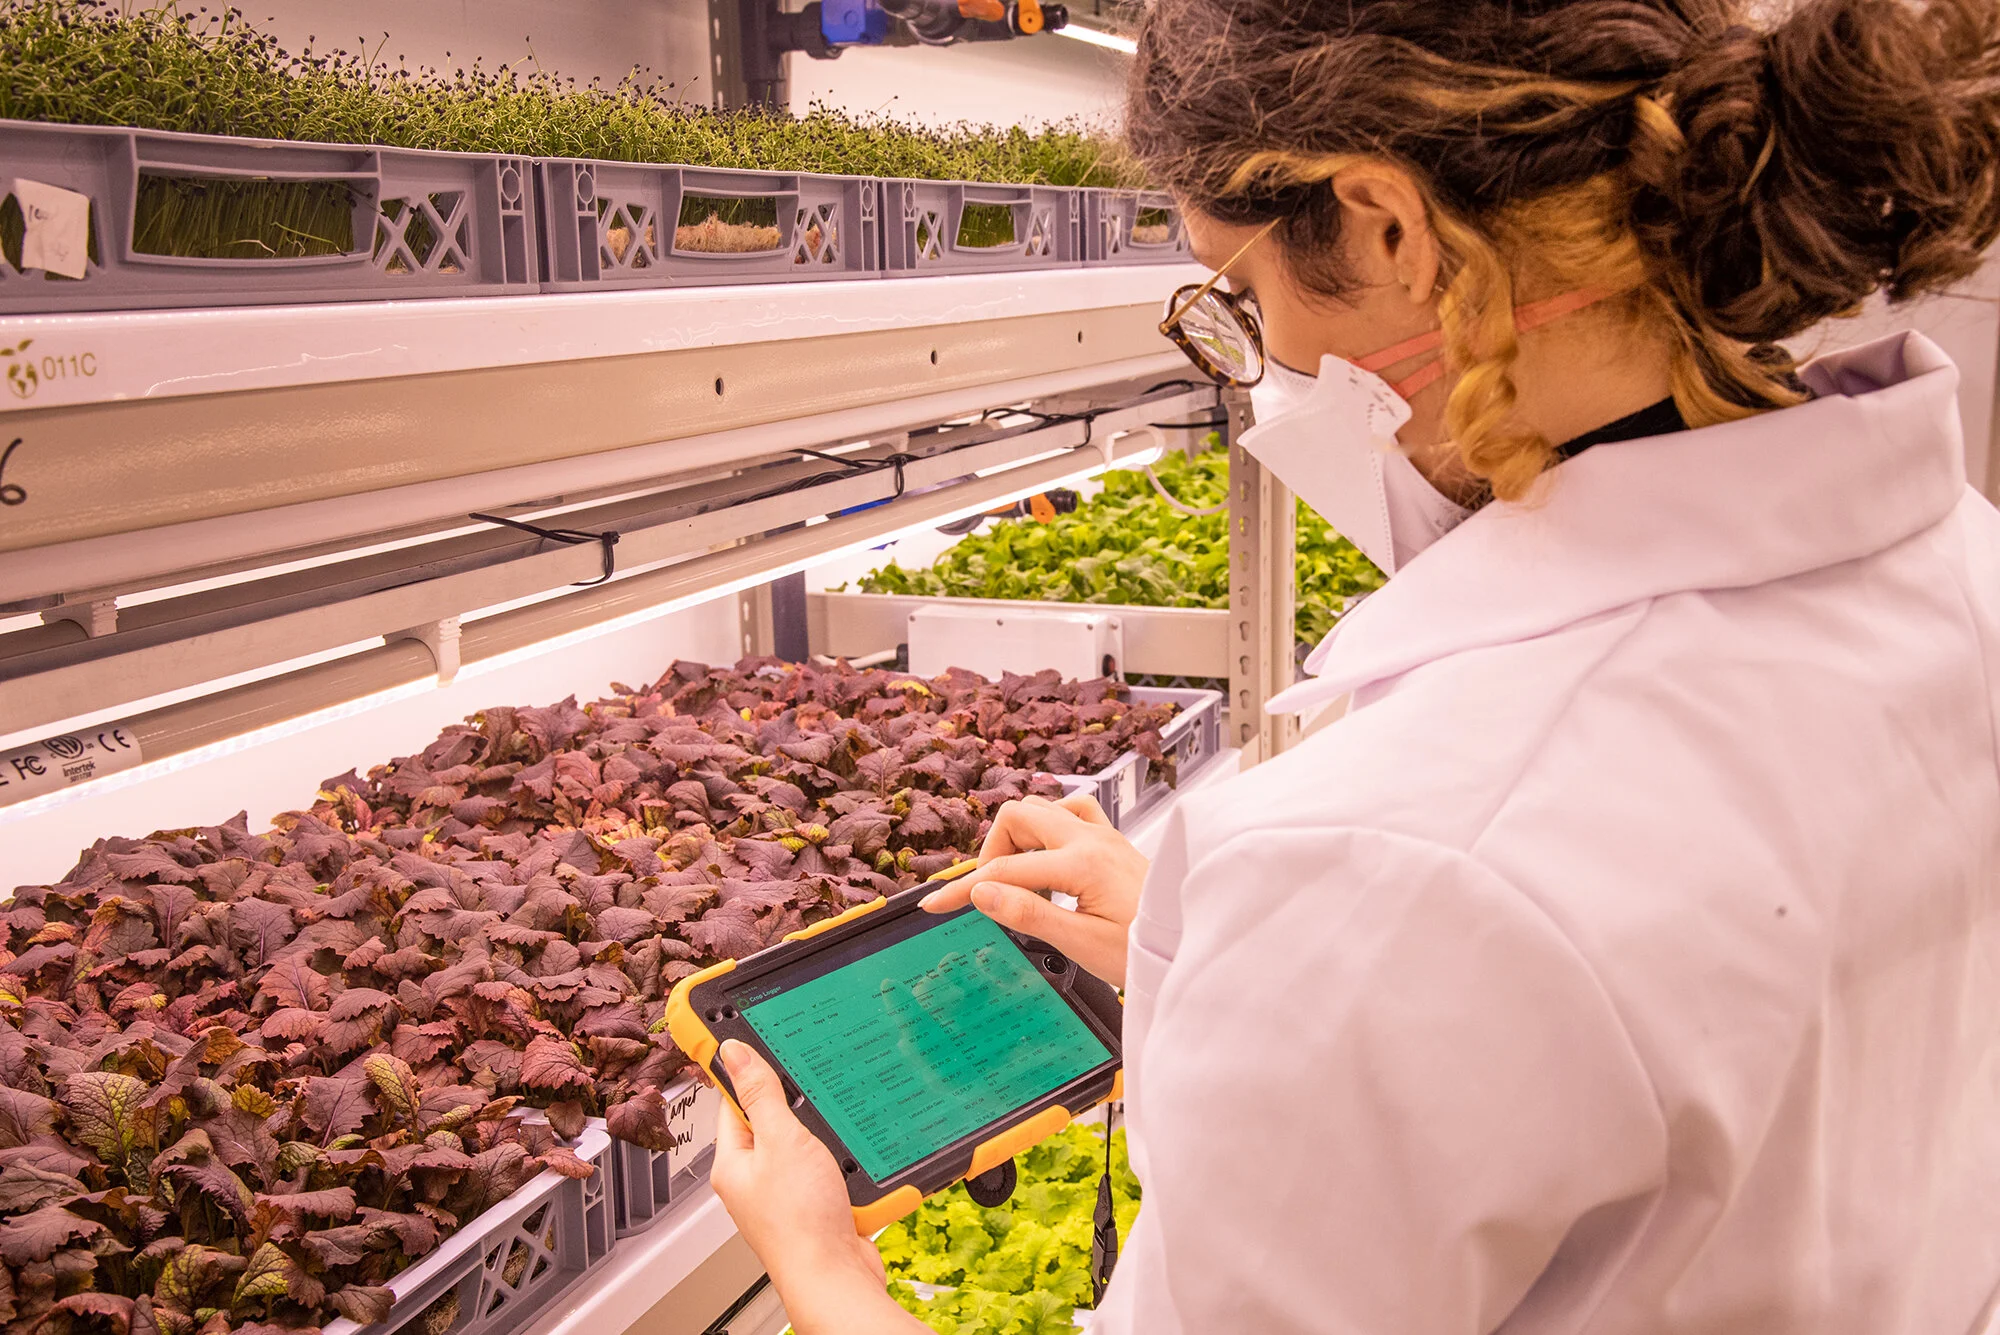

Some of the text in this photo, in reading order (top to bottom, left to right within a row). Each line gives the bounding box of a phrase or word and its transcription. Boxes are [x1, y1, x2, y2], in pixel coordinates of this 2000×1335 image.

[42, 352, 97, 381] 011C
[62, 760, 96, 777] Intertek
[748, 993, 764, 1003] Crop
[762, 985, 783, 998] Logger
